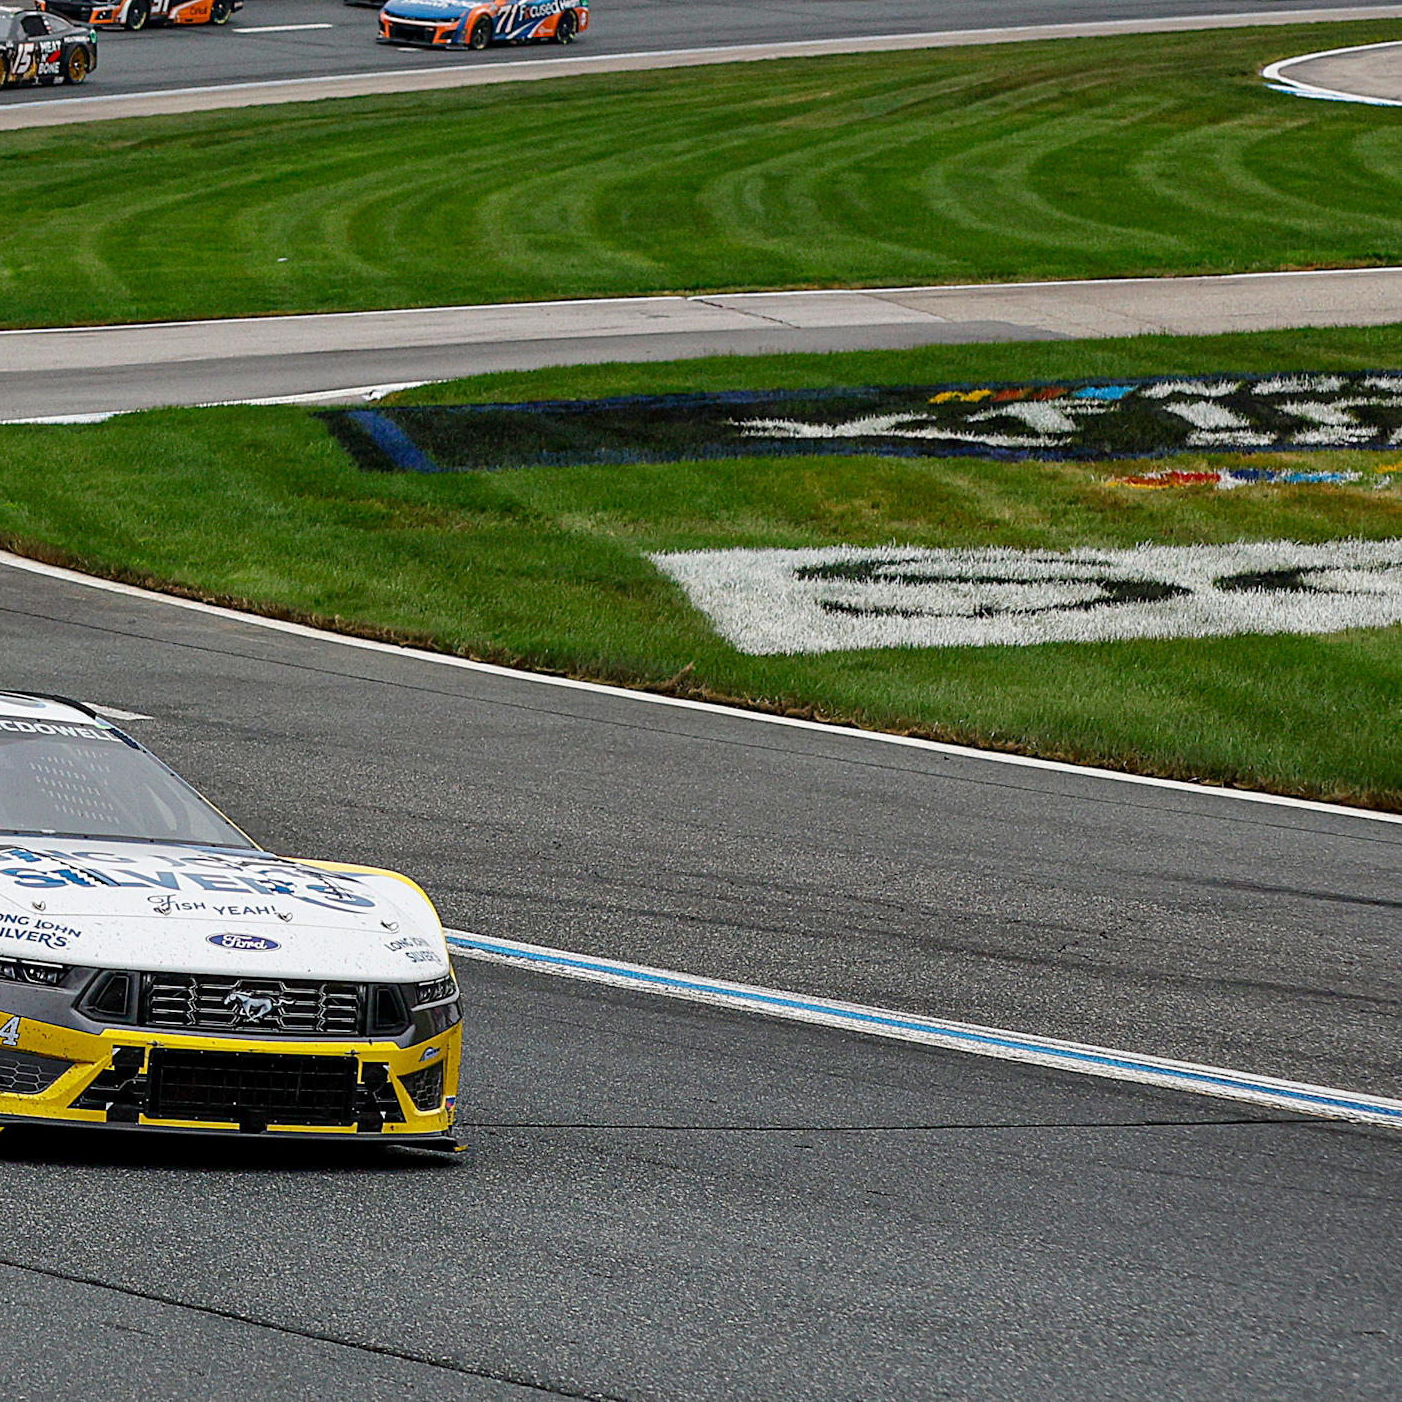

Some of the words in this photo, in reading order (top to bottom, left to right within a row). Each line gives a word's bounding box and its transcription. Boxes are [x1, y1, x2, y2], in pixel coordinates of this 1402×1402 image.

[497, 0, 518, 33] 71
[519, 0, 560, 21] Focused
[40, 41, 62, 53] MEAT
[11, 43, 35, 74] 15
[38, 62, 60, 75] BONE
[216, 904, 279, 918] YEAH!
[34, 919, 82, 939] JOHN
[218, 934, 269, 952] Ford
[384, 938, 407, 952] LONG
